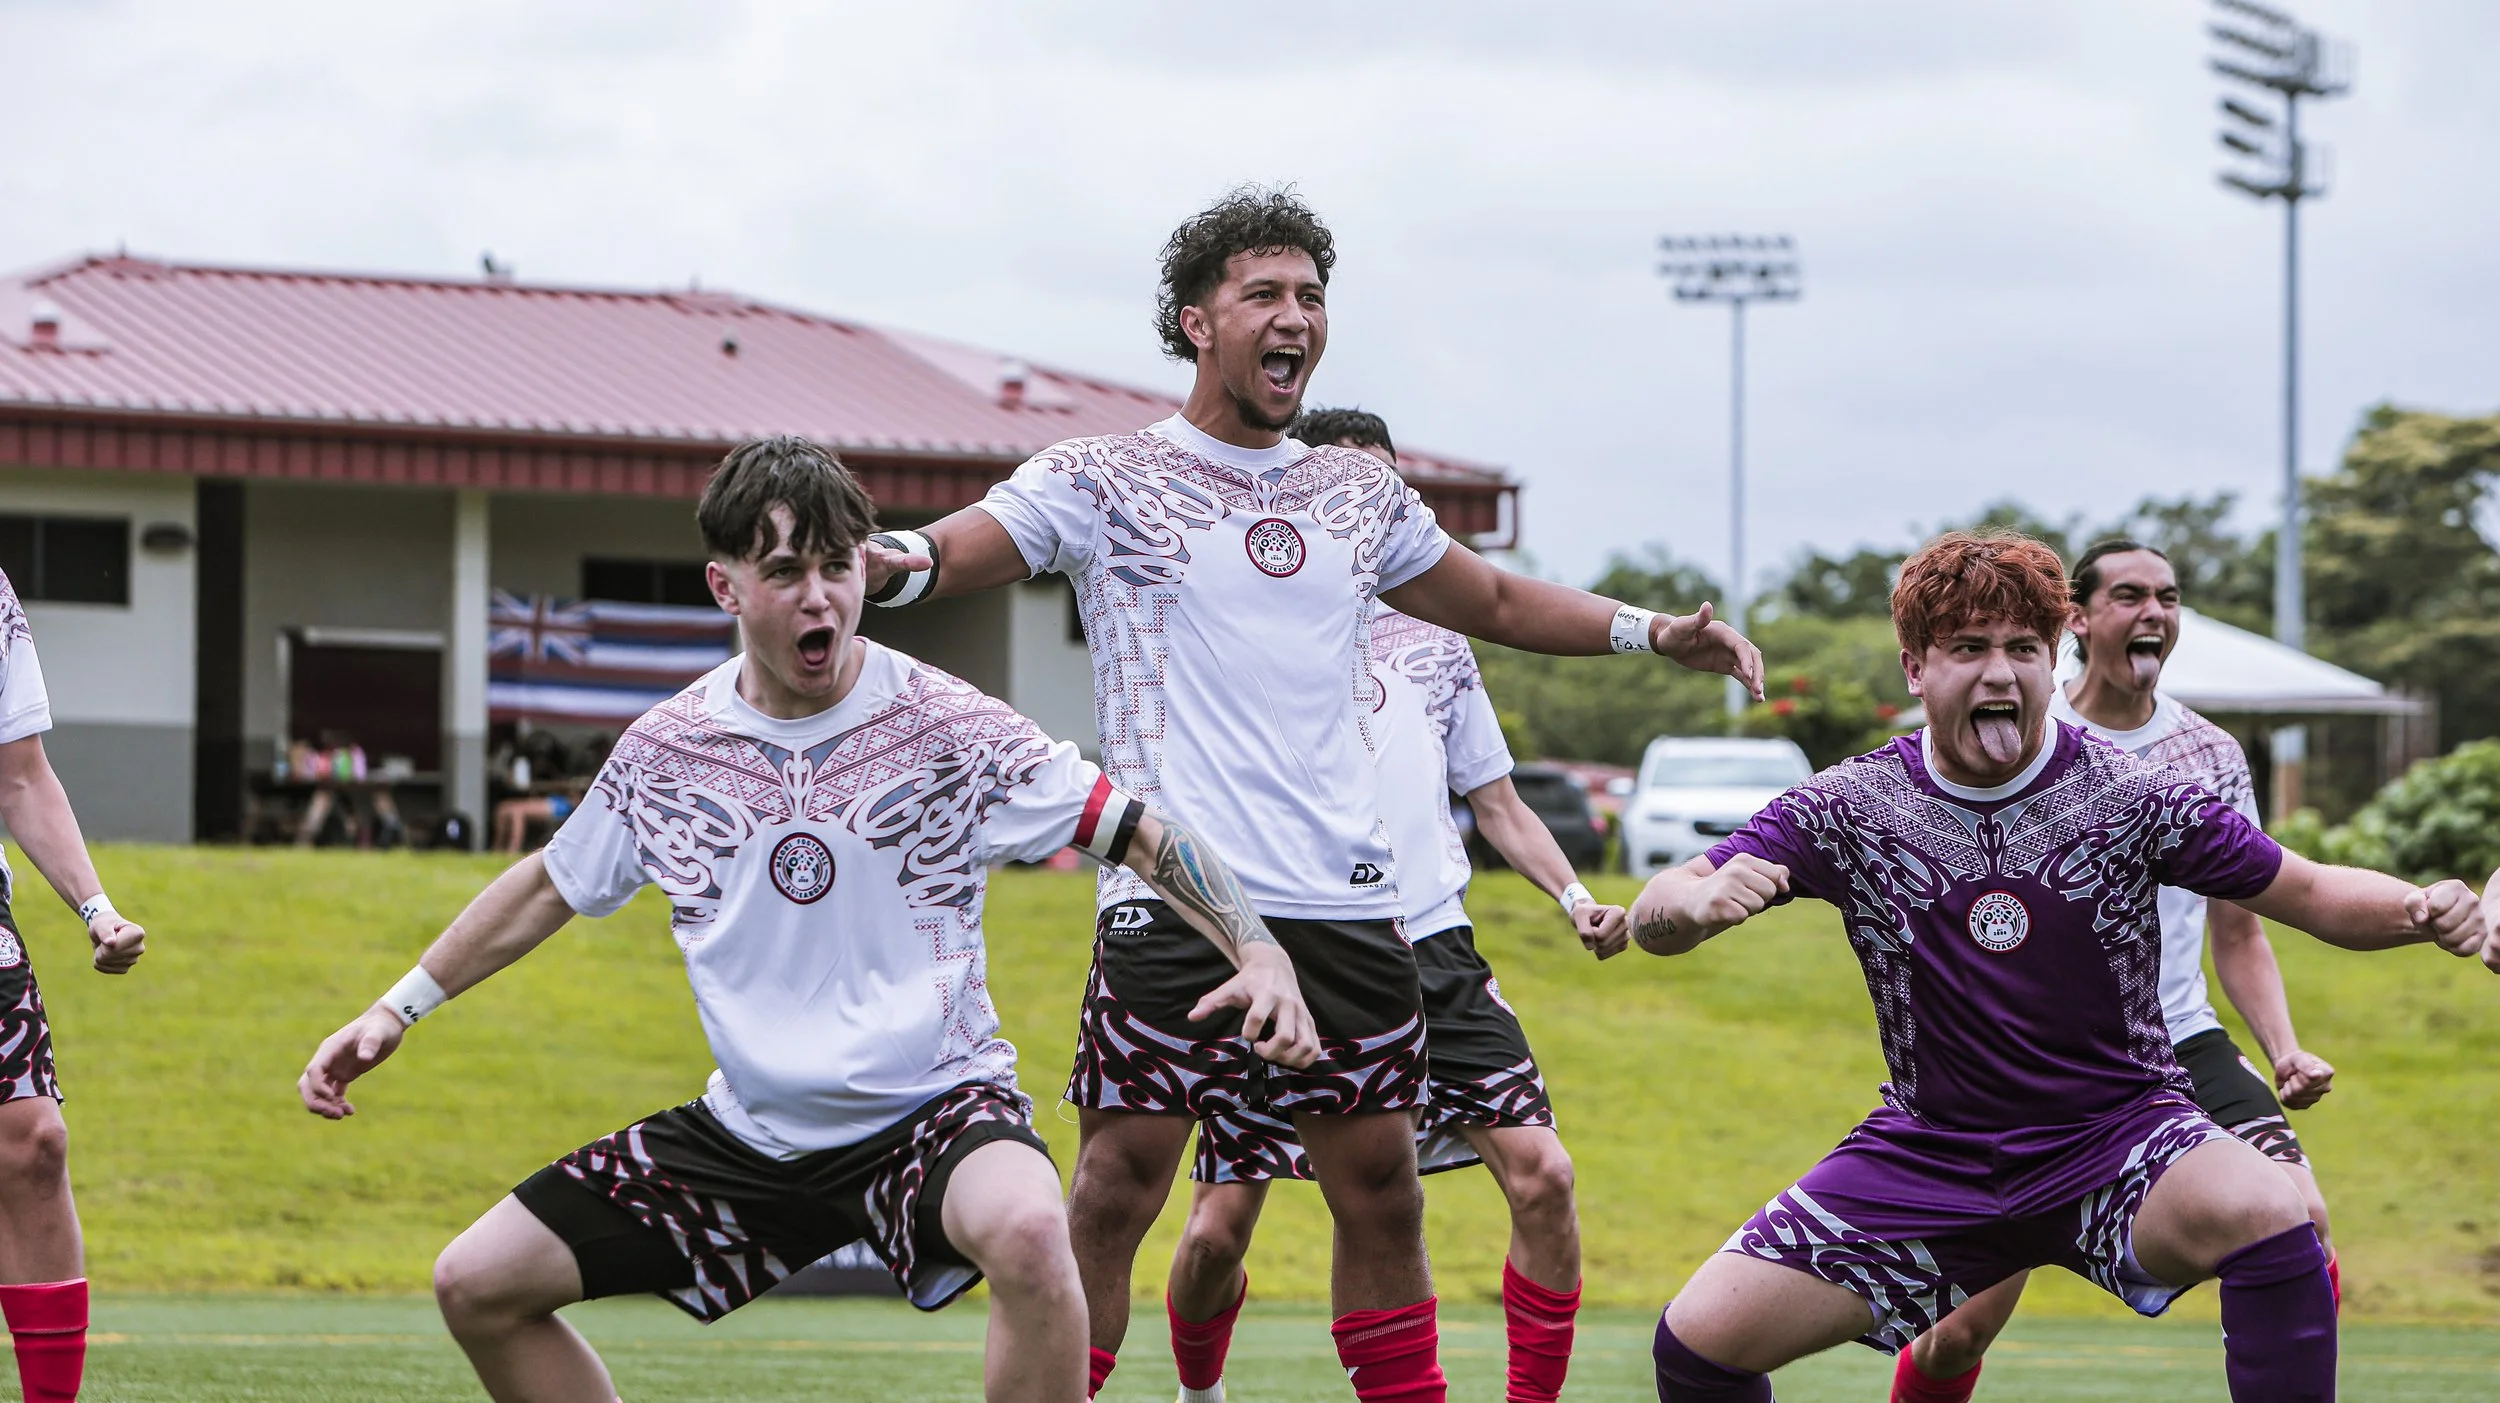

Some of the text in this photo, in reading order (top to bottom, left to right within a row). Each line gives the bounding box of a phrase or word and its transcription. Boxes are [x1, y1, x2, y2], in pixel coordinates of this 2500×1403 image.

[1270, 523, 1300, 549] FOOTBALL
[1260, 561, 1296, 573] AOTEAROA
[797, 838, 829, 867] FOOTBALL
[785, 884, 824, 898] AOTEAROA
[1970, 894, 2026, 922] MAORI FOOTBALL
[1980, 936, 2022, 950] AOTEAROA
